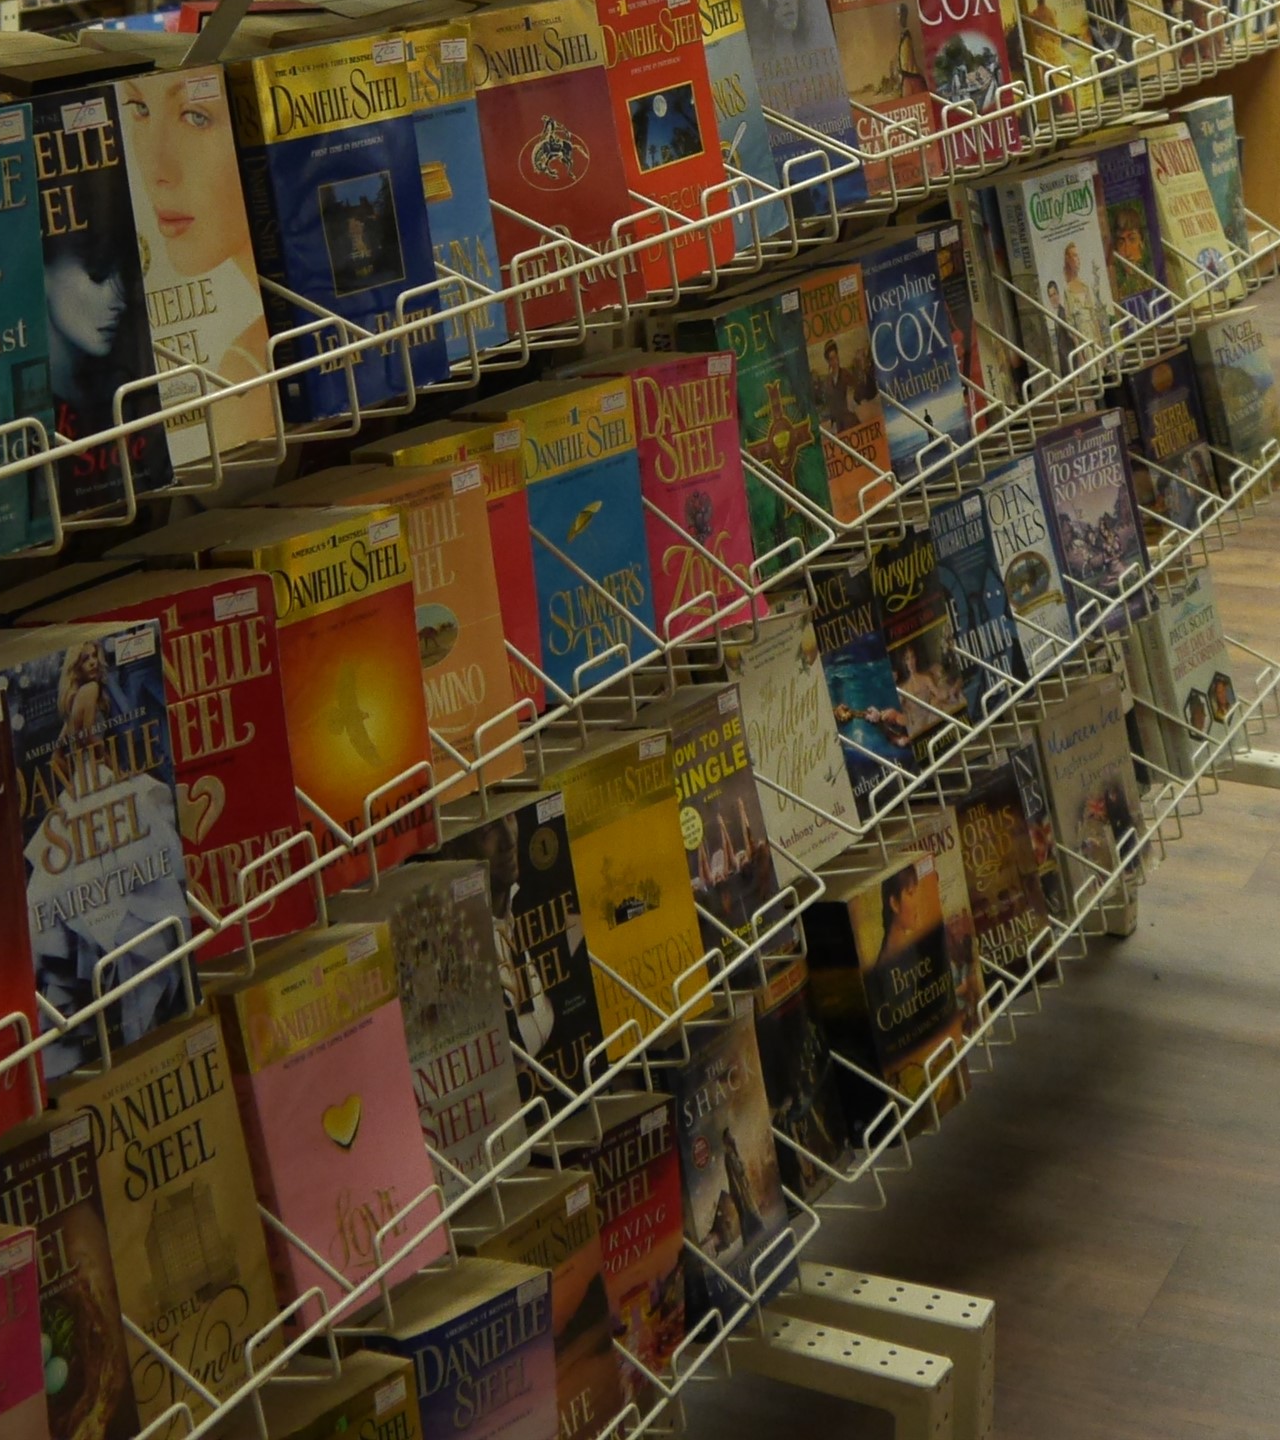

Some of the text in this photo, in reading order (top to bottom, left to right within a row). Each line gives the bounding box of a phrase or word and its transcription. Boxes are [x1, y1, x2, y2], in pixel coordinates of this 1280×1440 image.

[544, 26, 597, 71] STEEL
[600, 9, 703, 70] DANIELLE STEEL
[269, 67, 408, 136] DANIELLE STEEL
[866, 273, 937, 320] Josephine
[871, 300, 948, 372] COX
[1215, 332, 1265, 364] TRANTER
[1221, 320, 1255, 341] NIGEL
[634, 374, 733, 440] DANIELLE
[884, 361, 952, 403] Midnight
[1151, 399, 1189, 434] SIERRA
[1151, 418, 1199, 459] TRIUMPH
[525, 414, 632, 480] DANIELLE STEEL
[655, 427, 725, 485] STEEL
[1049, 444, 1119, 487] TO SLEEP
[1053, 463, 1123, 505] NO MORE
[290, 541, 328, 559] AMERICA'S
[994, 509, 1047, 566] JAKES
[271, 540, 407, 619] DANIELLE STEEL
[90, 706, 147, 734] BESTSELLER
[699, 717, 742, 754] TO BE
[41, 792, 151, 875] STEEL
[31, 846, 173, 934] FAIRYTALE
[876, 972, 953, 1033] Courtenay
[890, 955, 934, 997] Bryce
[67, 1049, 225, 1160] DANIELLE
[683, 1059, 756, 1128] SHACK
[123, 1117, 217, 1204] STEEL
[416, 1293, 547, 1398] DANIELLE
